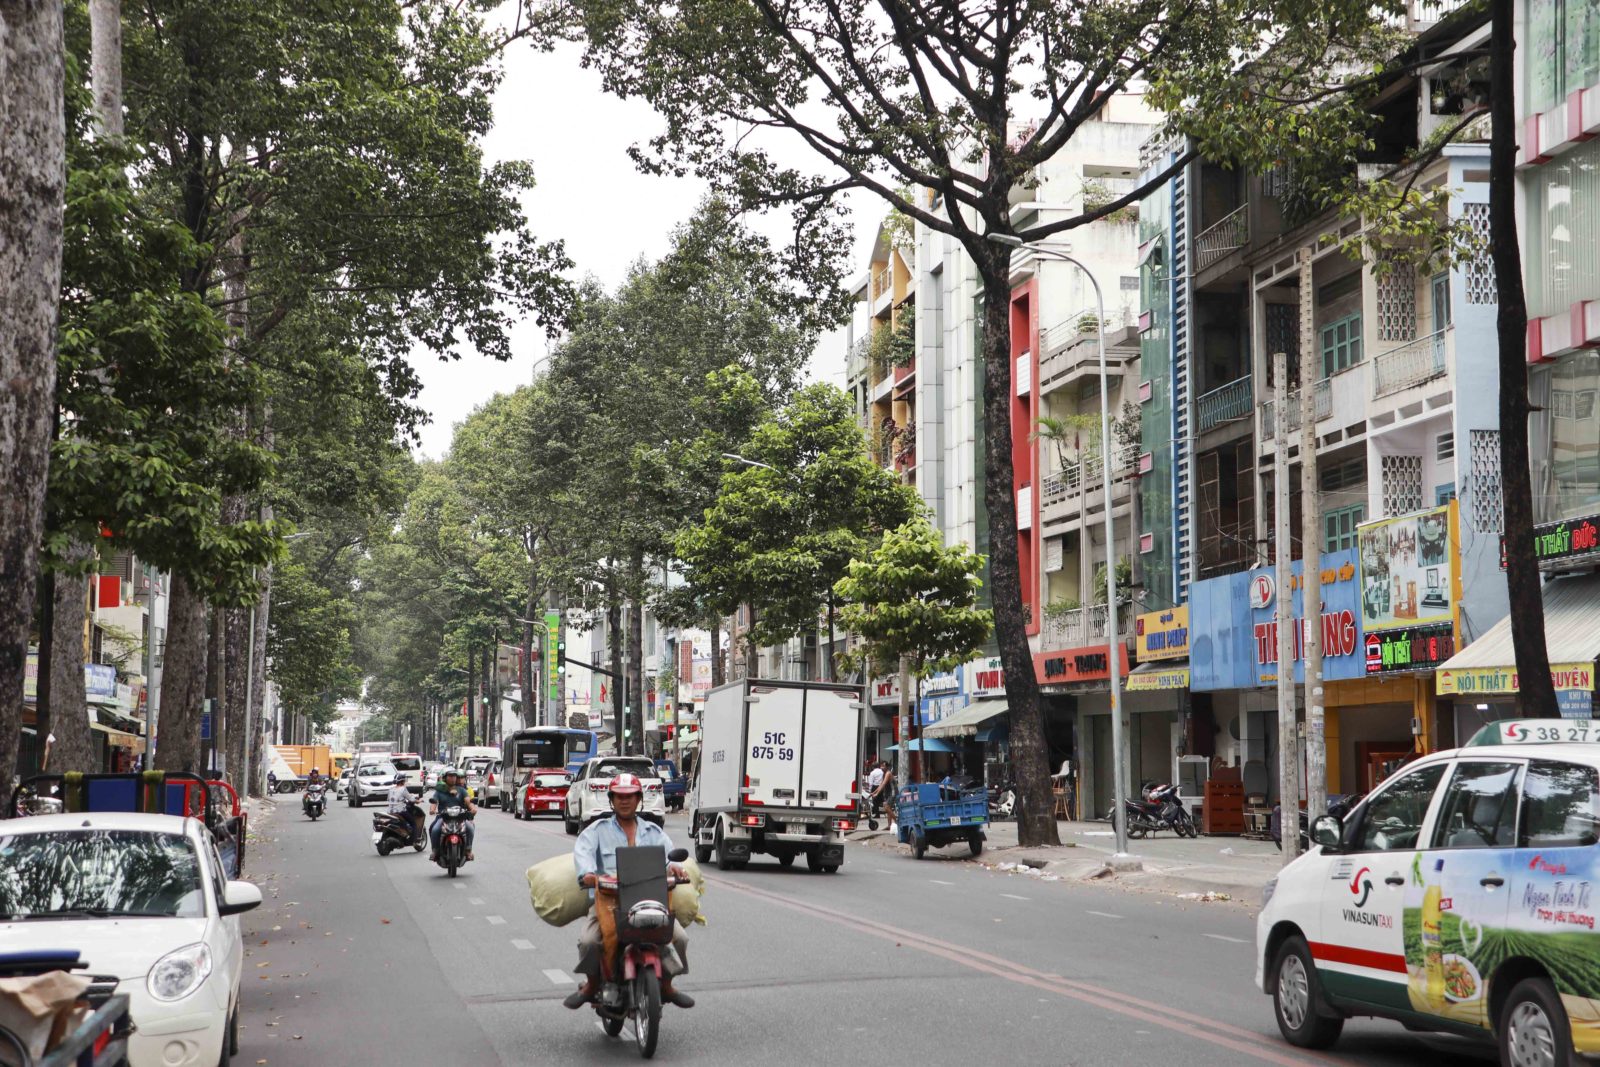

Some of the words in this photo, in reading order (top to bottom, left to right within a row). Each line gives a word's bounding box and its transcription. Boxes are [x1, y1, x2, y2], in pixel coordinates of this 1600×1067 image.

[1542, 523, 1569, 555] THẤT
[1478, 669, 1508, 690] THẤT
[764, 732, 786, 745] 51C
[1538, 728, 1560, 741] 38
[1568, 728, 1588, 742] 27
